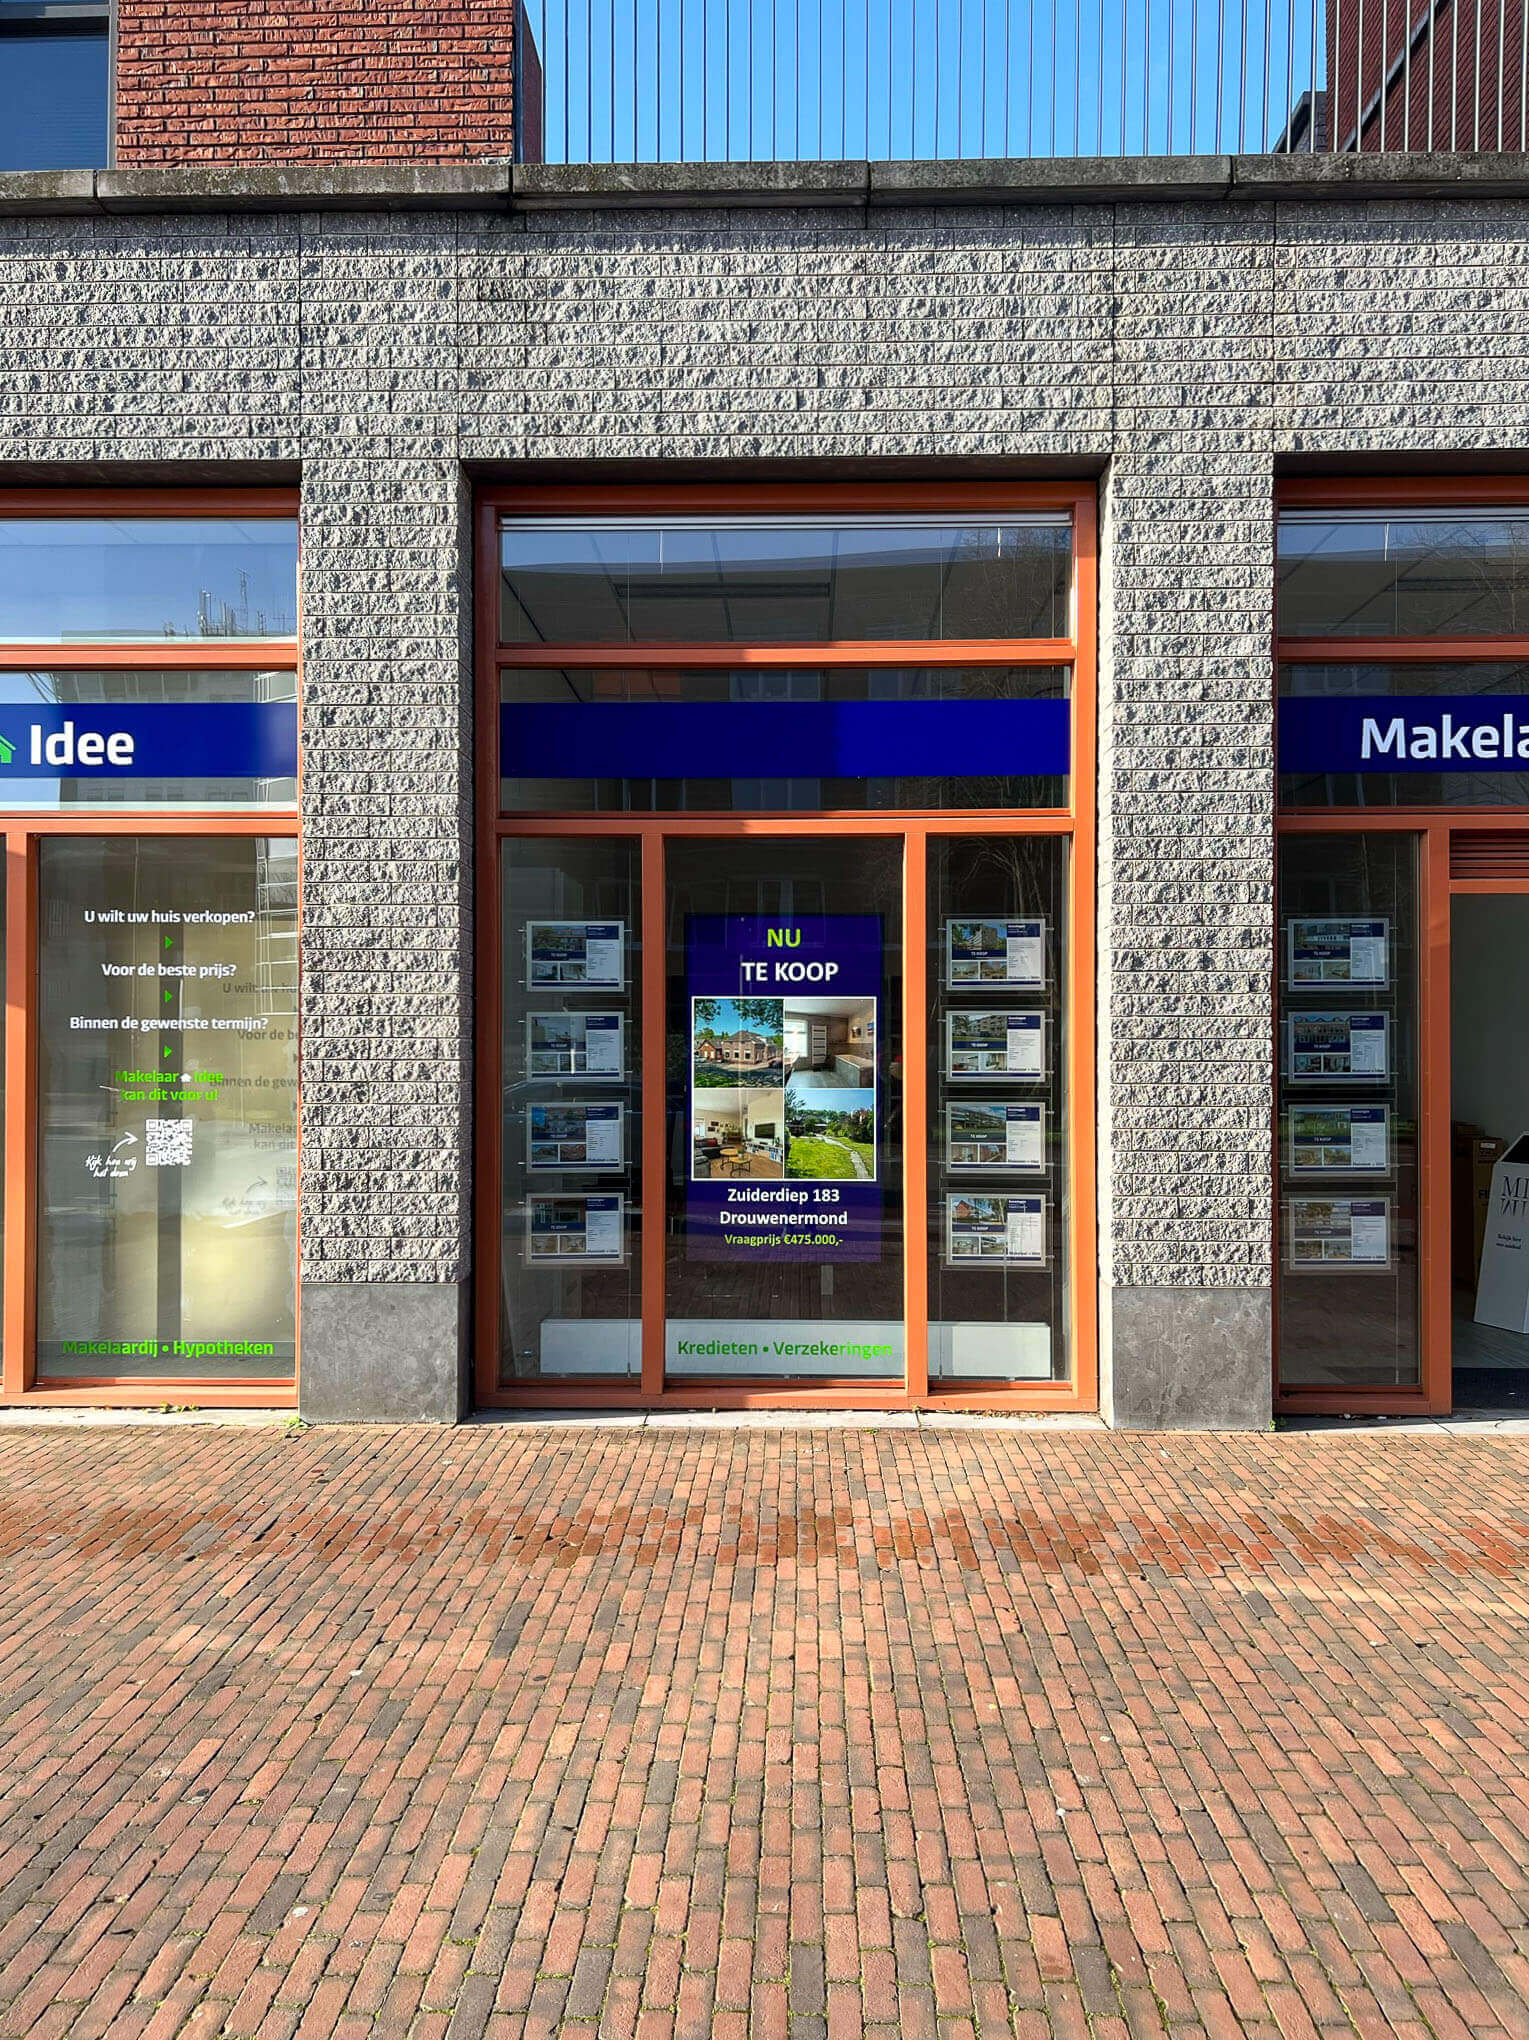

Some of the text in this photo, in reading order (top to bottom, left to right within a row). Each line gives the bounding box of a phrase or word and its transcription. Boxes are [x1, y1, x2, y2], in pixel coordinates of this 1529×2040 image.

[30, 721, 135, 766] Idee
[84, 910, 255, 926] U wilt uw huis verkopen?
[767, 928, 802, 948] NU
[102, 963, 237, 980] Voor de beste prijs?
[741, 962, 839, 982] TE KOOP
[70, 1017, 269, 1034] Binnen de gewenste termijn?
[115, 1069, 224, 1083] Makelaar Idee
[120, 1088, 219, 1101] kan dit voor u!
[727, 1188, 840, 1205] Zuiderdiep 183
[720, 1211, 848, 1226] Drouwenermond
[724, 1234, 843, 1248] Vraagprijs €475.000,-
[62, 1340, 274, 1358] Makelaardij Hypotheken
[678, 1340, 893, 1360] Kredieten Verzekeringen
